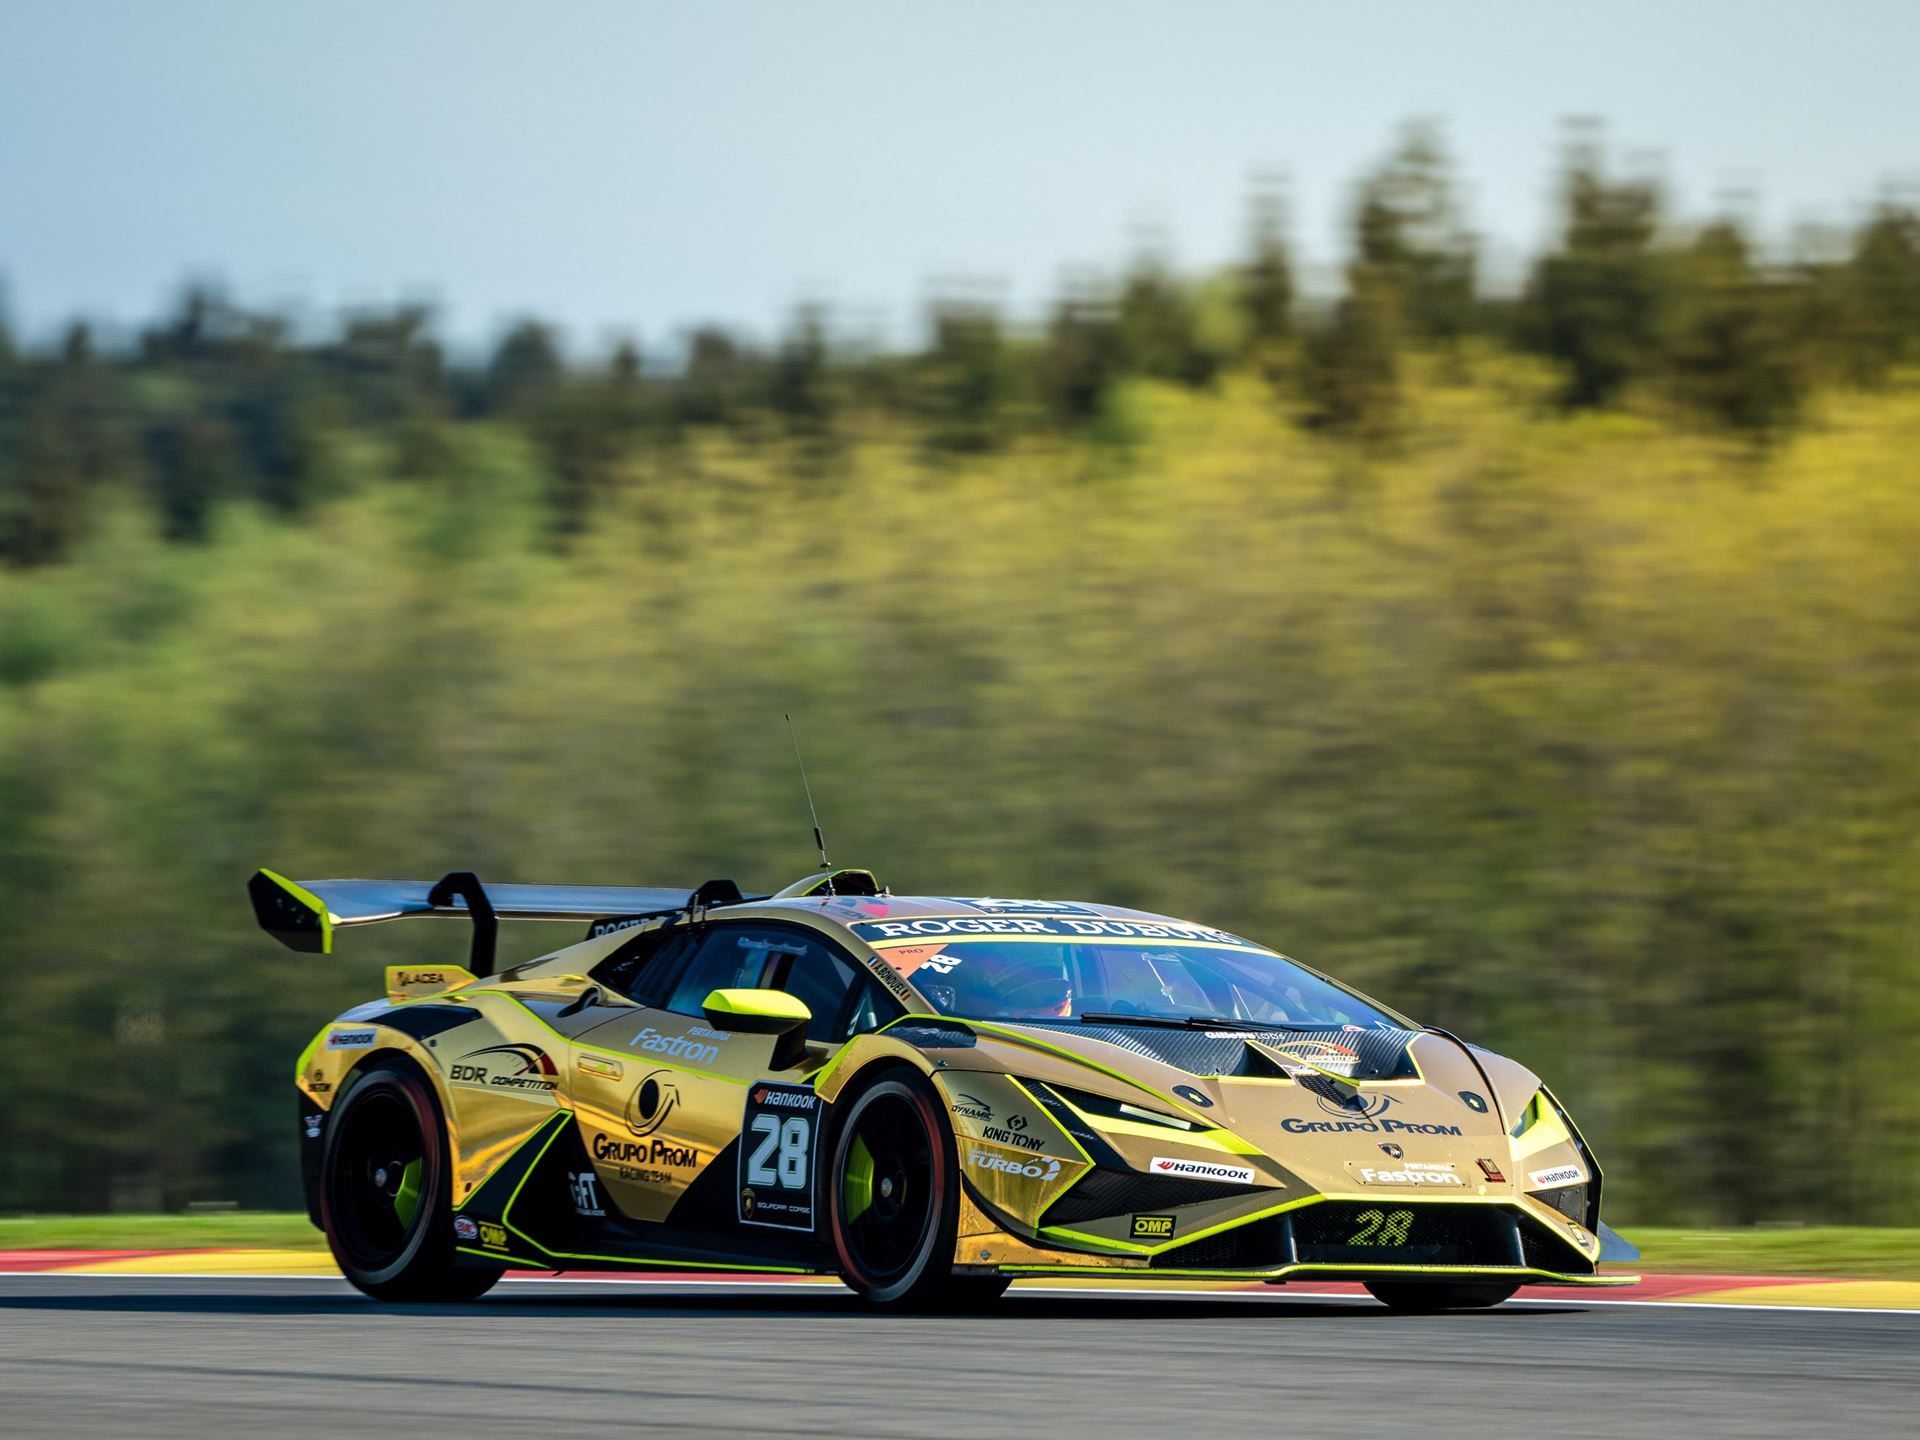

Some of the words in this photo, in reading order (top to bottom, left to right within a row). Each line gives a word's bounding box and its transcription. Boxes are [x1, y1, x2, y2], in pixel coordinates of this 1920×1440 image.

[872, 919, 1058, 937] ROGER
[1060, 919, 1242, 945] DUBUIS
[920, 954, 962, 974] 28
[629, 1027, 720, 1066] Fastron
[450, 1064, 488, 1085] BDR
[491, 1076, 560, 1091] COMPETITION
[951, 1104, 996, 1121] DYNAMIC
[983, 1126, 1011, 1143] KING
[1011, 1132, 1046, 1152] TONY
[1281, 1118, 1380, 1134] GRUPO
[1379, 1119, 1464, 1136] PROM
[593, 1132, 648, 1163] GRUPO
[650, 1139, 699, 1168] PROM
[747, 1113, 810, 1189] 28
[968, 1149, 1043, 1178] TURBO
[1360, 1168, 1462, 1185] Fastron
[480, 1225, 508, 1246] OMP
[1135, 1219, 1172, 1233] OMP
